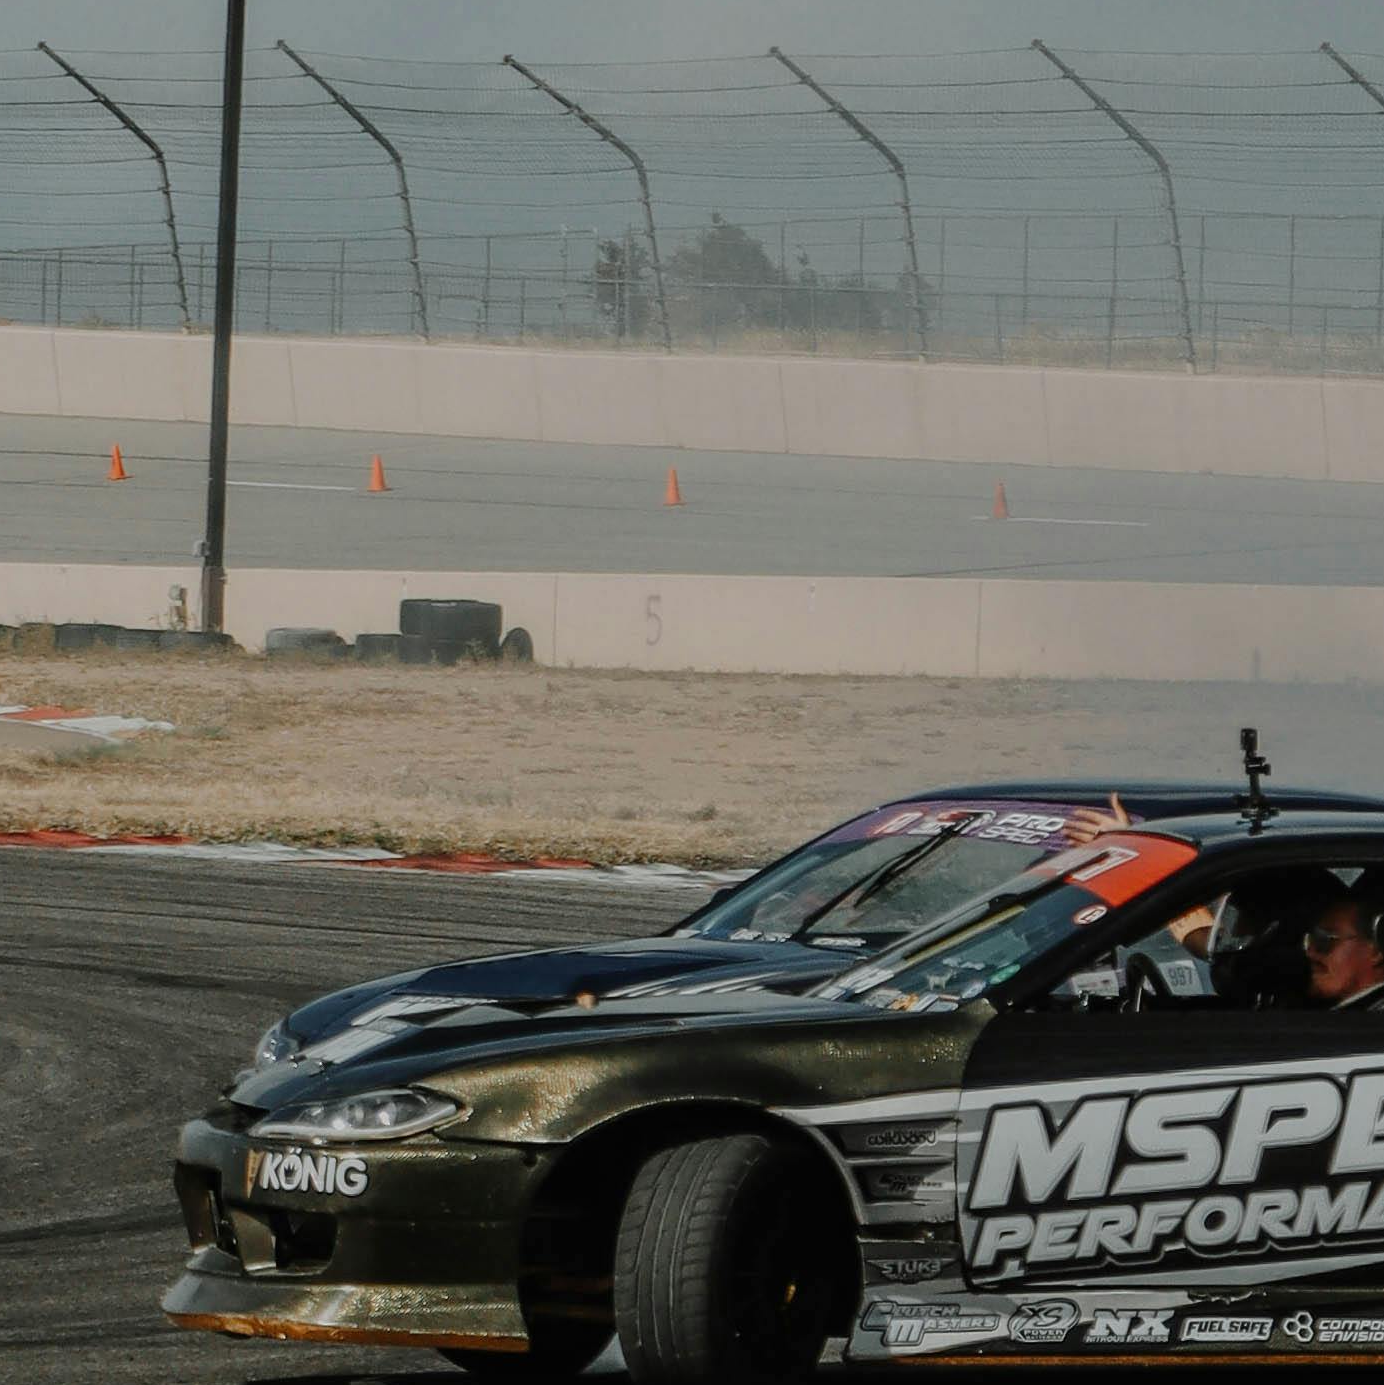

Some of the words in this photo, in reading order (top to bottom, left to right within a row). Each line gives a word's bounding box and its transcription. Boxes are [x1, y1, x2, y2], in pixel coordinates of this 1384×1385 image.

[645, 595, 663, 647] 5
[978, 826, 1050, 845] SPEC
[997, 813, 1066, 832] PRO
[259, 1146, 368, 1197] KÖNIG
[864, 1302, 959, 1328] CLUTCH
[1092, 1308, 1175, 1336] NX
[1186, 1321, 1227, 1336] FUEL
[1230, 1320, 1271, 1335] SAFE
[883, 1315, 1000, 1344] MASTERS
